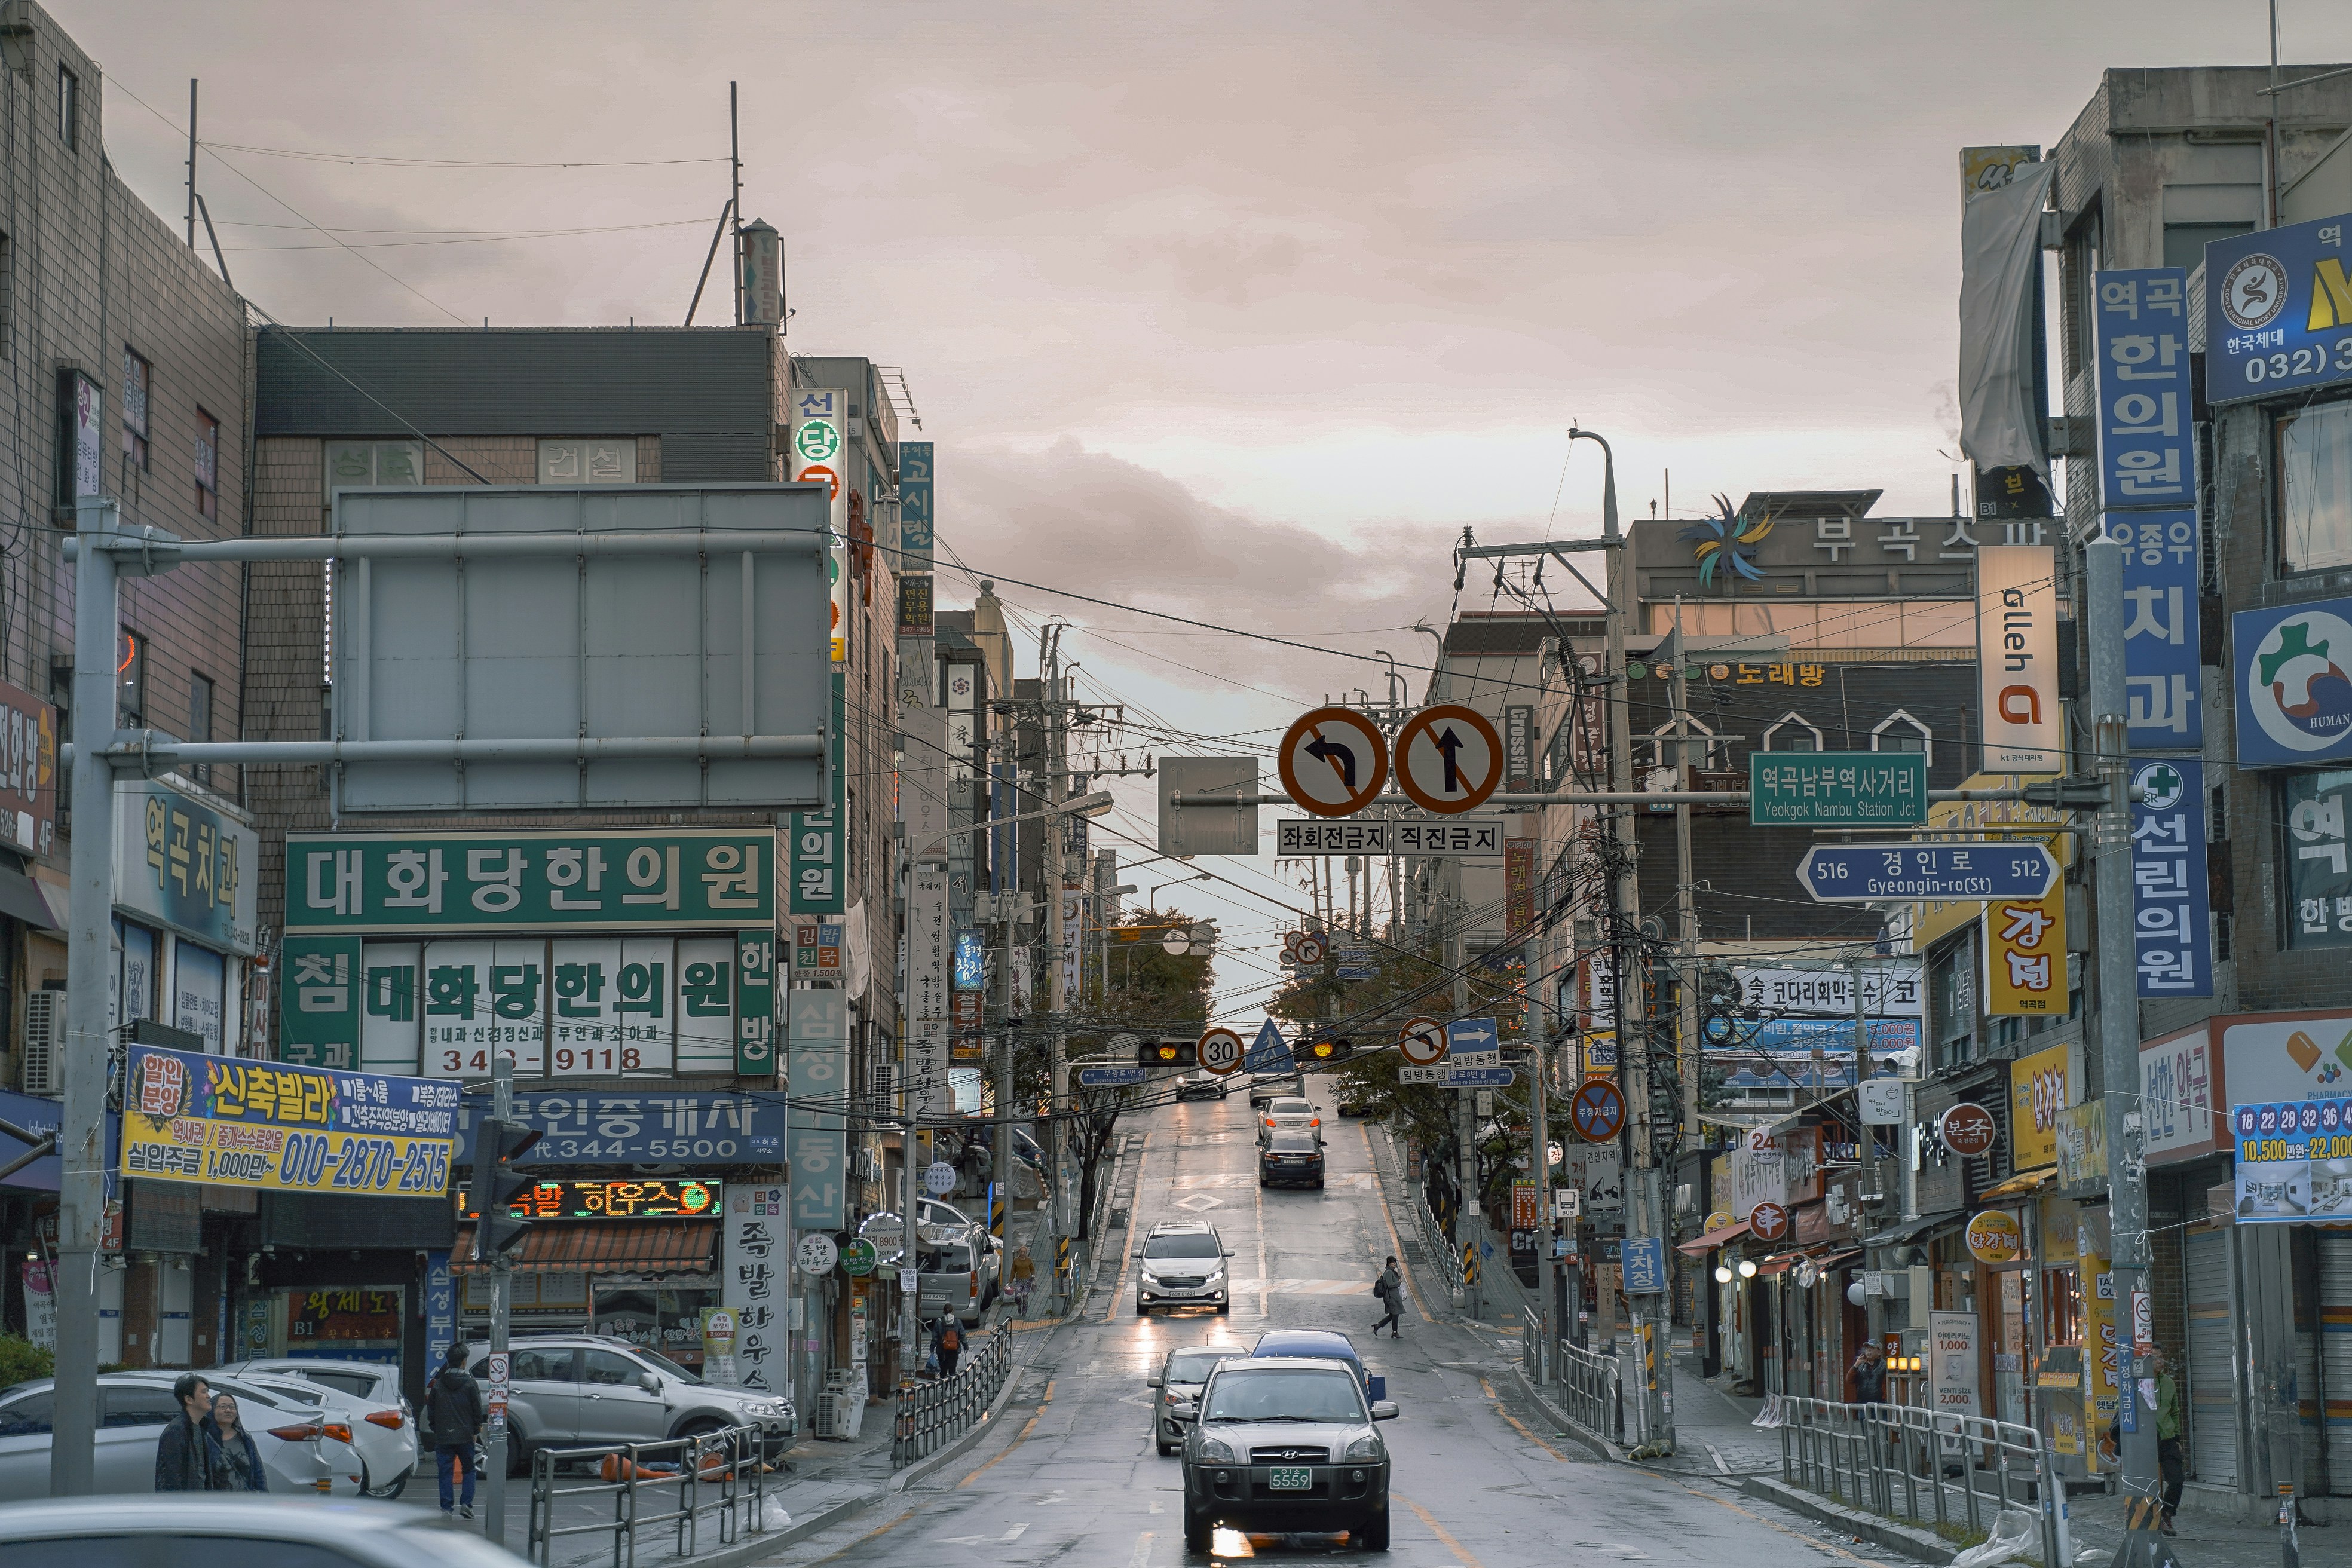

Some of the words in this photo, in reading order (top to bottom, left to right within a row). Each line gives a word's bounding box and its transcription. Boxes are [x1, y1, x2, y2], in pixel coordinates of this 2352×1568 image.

[2101, 278, 2183, 320] 역곡
[2227, 329, 2284, 355] 한국체대
[548, 446, 622, 478] 건설
[902, 460, 933, 546] 고시텔
[1980, 503, 1996, 515] B1
[1735, 663, 1826, 687] 노래방
[2011, 754, 2044, 762] 공식대리점
[1762, 766, 1914, 798] 역곡남부역사거리
[1764, 801, 1809, 821] Yeokgok
[1815, 801, 1852, 817] Nambu
[1858, 801, 1894, 817] Station
[1899, 801, 1916, 817] Jct
[1283, 825, 1386, 850] 좌회전금지
[1400, 826, 1497, 850] 직진금지
[145, 794, 239, 921] 역곡치과
[1882, 851, 1973, 877] 경인로
[305, 844, 760, 917] 대화당한의원
[1817, 862, 1849, 880] 516
[2011, 860, 2041, 877] 512
[1867, 877, 1992, 895] Gyeongin-ro(St)
[2130, 814, 2195, 990] 선린의원
[800, 926, 839, 945] 김밥
[800, 950, 837, 966] 천국
[366, 961, 731, 1023] 대화당한의원
[742, 942, 772, 1061] 한방
[2019, 1000, 2047, 1009] 역곡점
[1209, 1042, 1234, 1061] 30
[1453, 1053, 1497, 1068] 일방통행
[143, 1053, 183, 1086] 할인
[1104, 1069, 1144, 1077] 부광로7번길
[1403, 1068, 1446, 1081] 일방통행
[141, 1084, 180, 1117] 분양
[213, 1062, 332, 1126] 신축빌라
[415, 1110, 452, 1134] 엘리베이터
[1578, 1107, 1618, 1118] 주정차금지
[2241, 1113, 2253, 1130] 18
[2261, 1112, 2276, 1129] 22
[2281, 1110, 2296, 1128] 28
[2302, 1109, 2317, 1127] 32
[2323, 1108, 2338, 1126] 36
[172, 1118, 205, 1142] 역세권
[1946, 1118, 1992, 1143] 본죽
[127, 1141, 203, 1174] 실입주금
[279, 1132, 449, 1193] 010-2870-2515
[1587, 1149, 1616, 1164] 견인지역
[801, 1244, 829, 1255] 족발
[879, 1236, 897, 1247] 8900
[799, 1257, 831, 1266] 하우스
[1627, 1239, 1655, 1287] 주차장
[738, 1221, 774, 1393] 족발하우스
[293, 1321, 314, 1336] B1
[1937, 1331, 1971, 1340] 아메리카노
[1272, 1475, 1309, 1487] 5559
